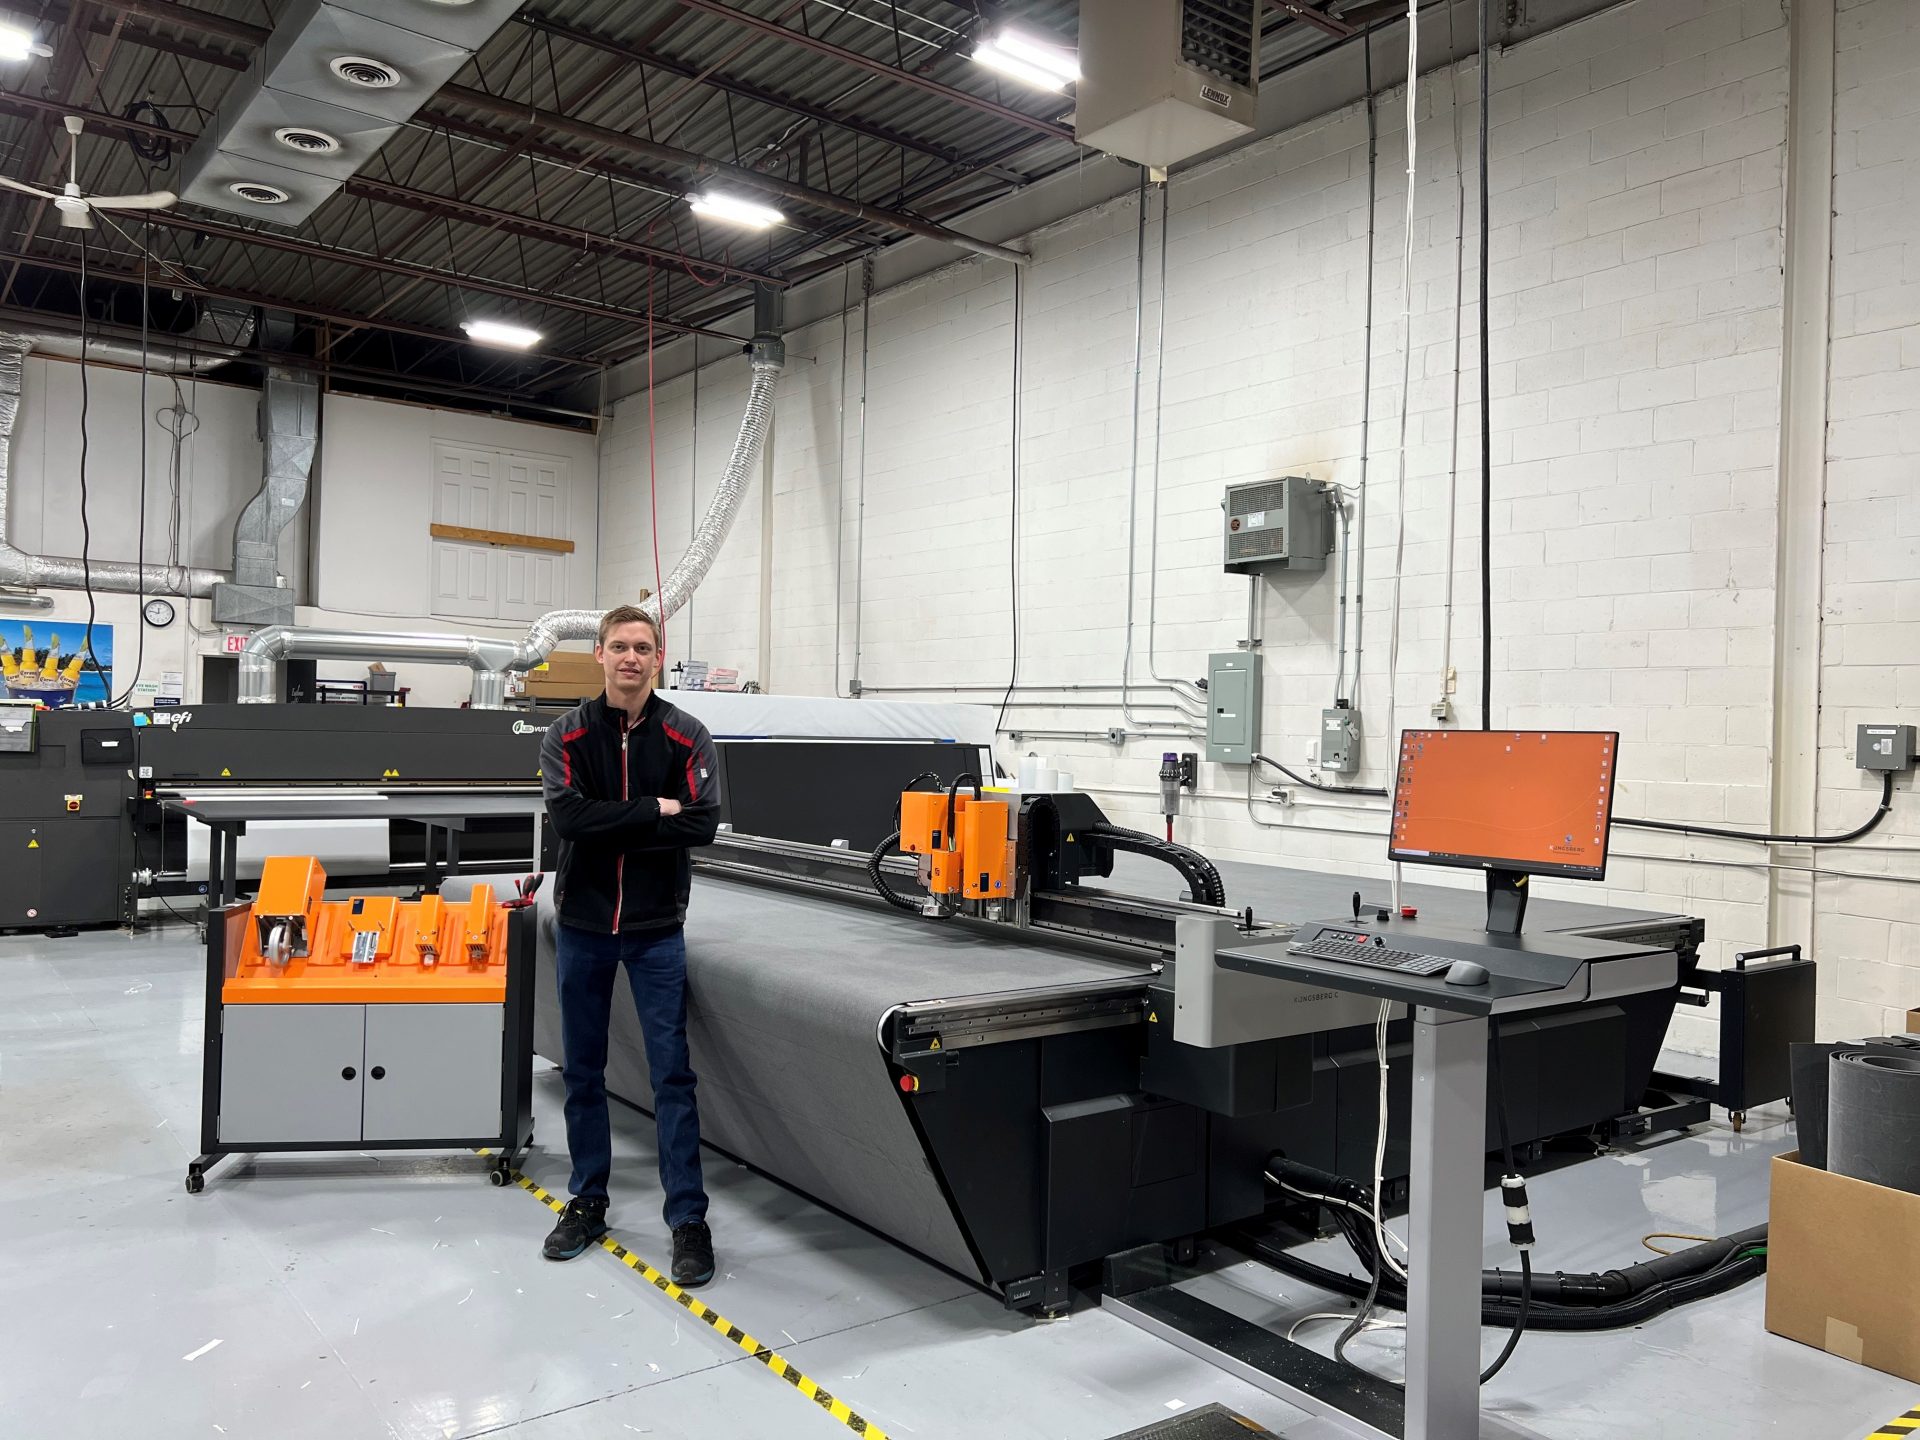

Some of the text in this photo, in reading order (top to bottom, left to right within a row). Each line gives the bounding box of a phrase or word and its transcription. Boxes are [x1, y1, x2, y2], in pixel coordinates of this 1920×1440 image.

[1202, 86, 1229, 104] LENNOX
[227, 636, 249, 651] EXIT
[170, 711, 193, 725] efi
